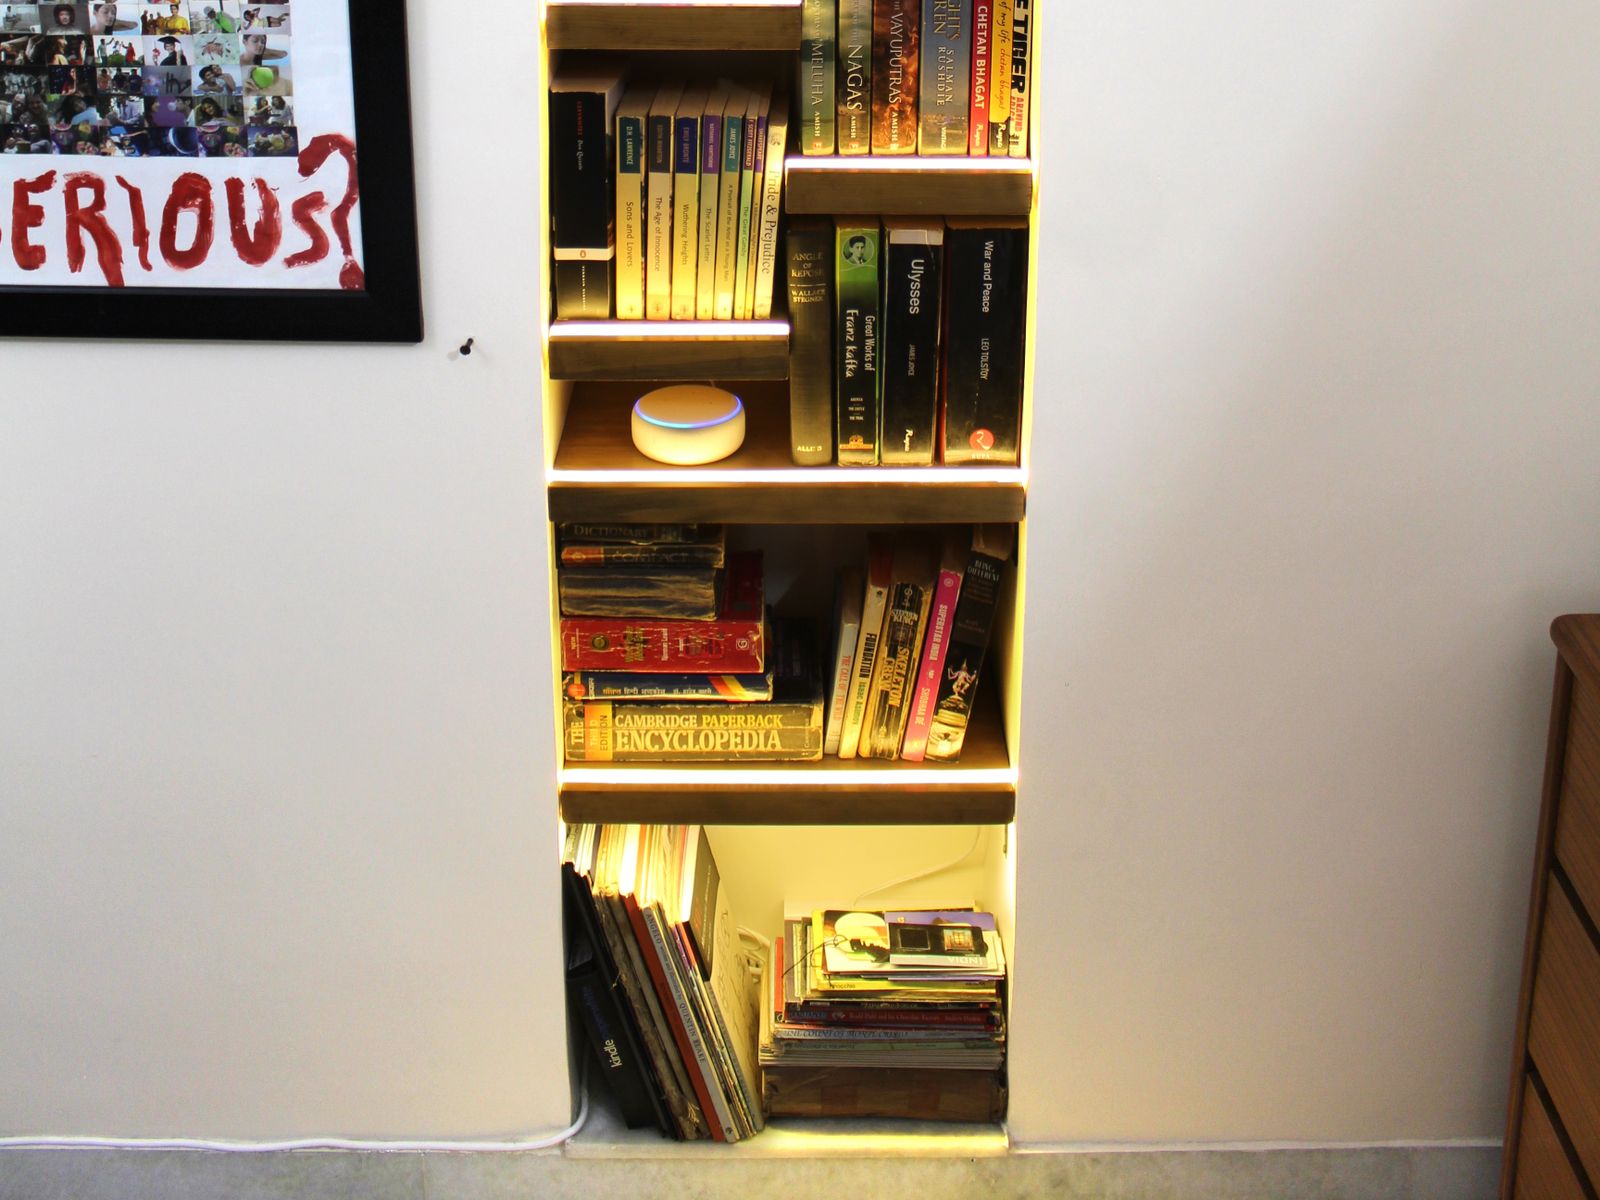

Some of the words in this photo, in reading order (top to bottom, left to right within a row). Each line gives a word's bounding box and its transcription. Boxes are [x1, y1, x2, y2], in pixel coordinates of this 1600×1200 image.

[976, 5, 988, 55] CHETAN
[888, 12, 904, 104] VAYUPUTRAS
[811, 42, 824, 106] MELUHA
[846, 43, 863, 111] NAGAS
[936, 46, 946, 106] RUSHDIE
[946, 49, 955, 103] SALMAN
[975, 59, 987, 109] BHAGAT
[890, 110, 899, 142] AMISH
[1015, 97, 1025, 132] ARAVIND
[766, 170, 779, 201] Pride
[0, 132, 365, 290] ERIOUS?
[625, 201, 635, 221] Sons
[654, 212, 662, 225] Age
[680, 204, 690, 239] Wuthering
[765, 205, 778, 216] &
[626, 223, 635, 239] and
[655, 225, 663, 234] of
[626, 242, 634, 268] Lovers
[654, 235, 662, 272] Innocence
[680, 240, 690, 266] Heights
[760, 219, 777, 275] Prejudice
[983, 240, 994, 260] War
[982, 262, 993, 281] and
[907, 259, 925, 315] Ulysses
[981, 283, 993, 313] Peace
[864, 315, 875, 338] Great
[864, 339, 876, 362] Works
[980, 338, 989, 351] LEO
[864, 363, 876, 371] of
[907, 361, 915, 376] JOYCE
[979, 352, 990, 380] TOLSTOY
[933, 605, 947, 643] SUPERSTAR
[859, 633, 876, 678] FOUNDATION
[930, 644, 940, 660] INDIA
[881, 658, 894, 691] CREW
[889, 648, 909, 707] SKELETON
[570, 722, 584, 745] THE
[600, 714, 609, 751] EDITION
[614, 713, 698, 729] CAMBRIDGE
[701, 713, 784, 728] PAPERBACK
[615, 728, 783, 752] ENCYCLOPEDIA
[947, 955, 987, 965] INDIA
[645, 912, 662, 944] ANGELO
[678, 1003, 696, 1037] QUENTIN
[692, 1039, 706, 1064] BLAKE
[605, 1040, 622, 1069] kindle
